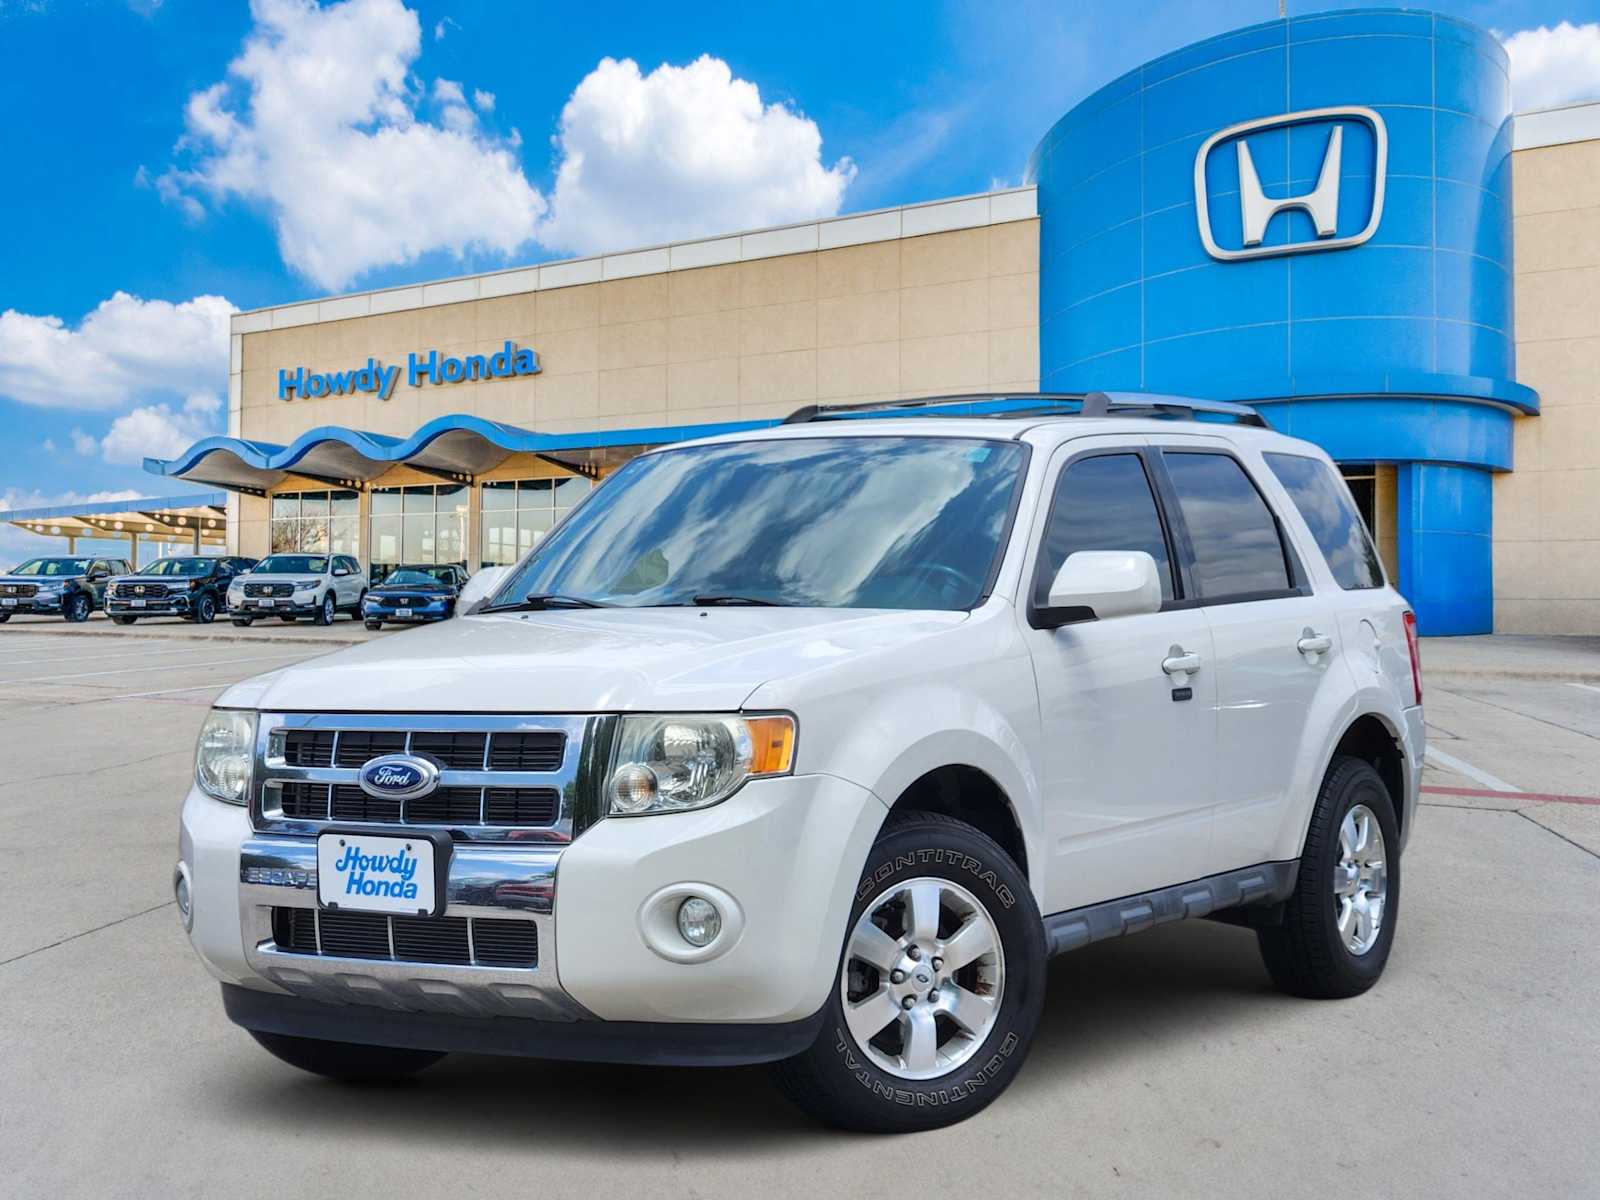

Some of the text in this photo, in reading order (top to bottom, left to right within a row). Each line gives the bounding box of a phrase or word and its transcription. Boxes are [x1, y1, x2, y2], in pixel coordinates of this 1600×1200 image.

[277, 340, 541, 401] Howdy Honda
[374, 765, 412, 786] Ford
[335, 846, 418, 881] Howdy
[345, 871, 418, 899] Honda
[856, 848, 1016, 909] CONTITRAC
[834, 1027, 1019, 1106] CONTINENTAL
